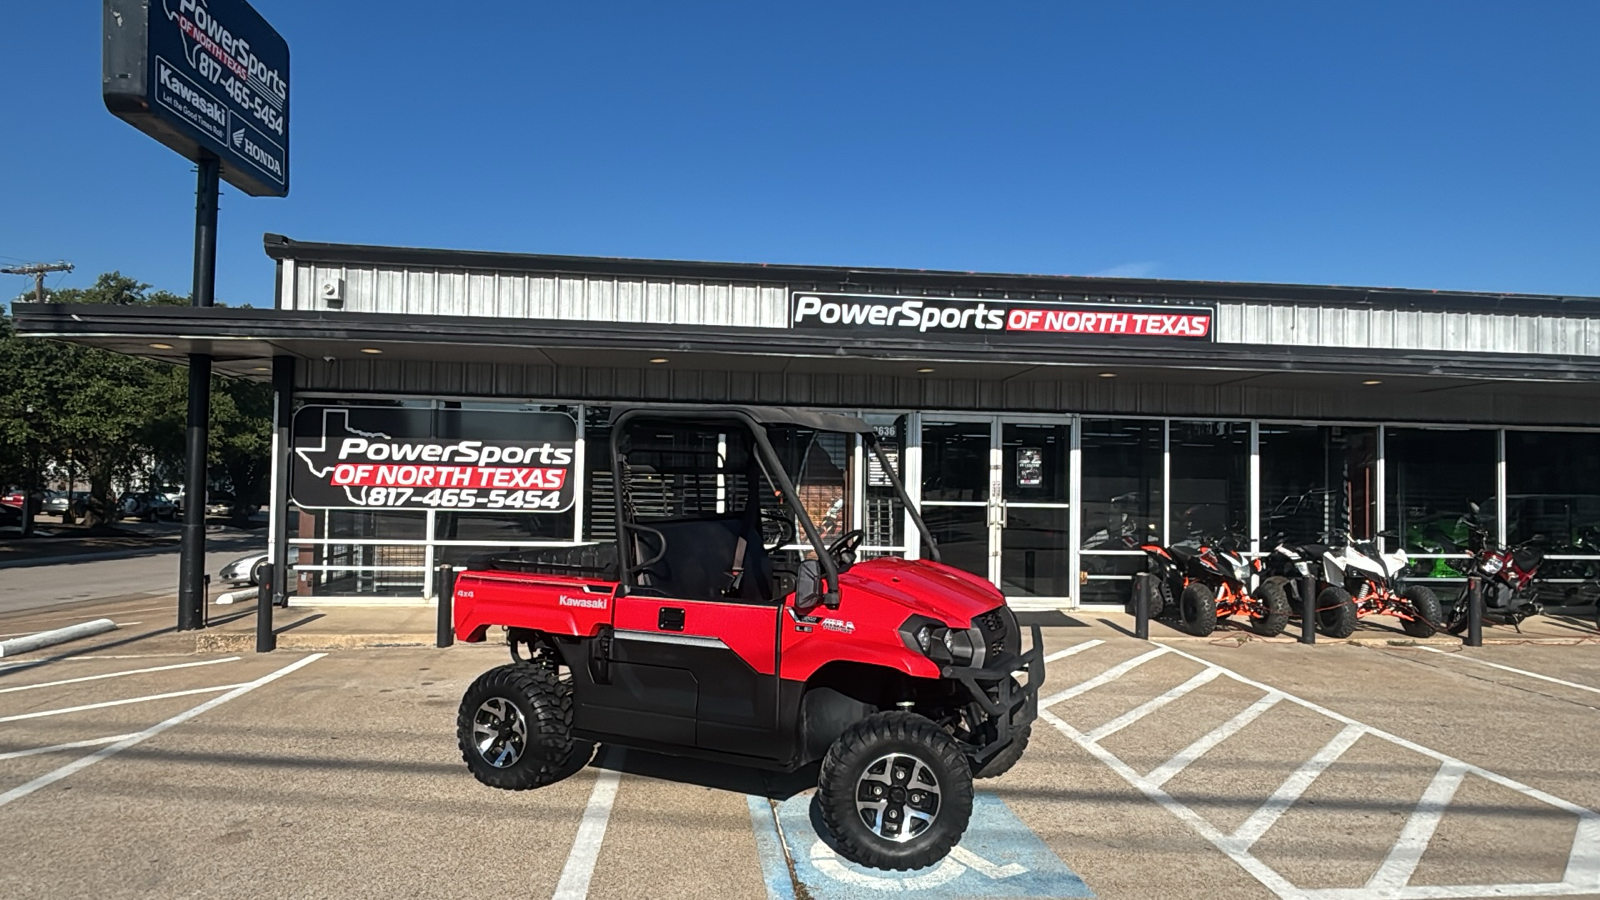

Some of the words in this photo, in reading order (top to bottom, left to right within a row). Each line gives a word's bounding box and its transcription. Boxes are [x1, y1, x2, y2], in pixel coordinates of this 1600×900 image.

[180, 16, 194, 34] OF
[193, 27, 223, 60] NORTH
[222, 52, 247, 80] TEXAS
[160, 63, 226, 127] Kawasaki
[162, 91, 173, 105] Let
[173, 98, 182, 113] the
[182, 105, 198, 122] Good
[198, 116, 213, 133] Times
[199, 52, 284, 136] 817-465-5454
[244, 138, 282, 177] HONDA
[795, 296, 1005, 332] PowerSports
[1008, 310, 1041, 329] OF
[1044, 312, 1126, 332] NORTH
[1132, 316, 1206, 336] TEXAS
[338, 438, 573, 466] PowerSports
[335, 465, 376, 484] OF
[376, 465, 473, 487] NORTH
[477, 467, 563, 488] TEXAS
[367, 487, 560, 509] 817-465-5454
[457, 590, 474, 598] 4x4
[559, 595, 608, 609] Kawasaki
